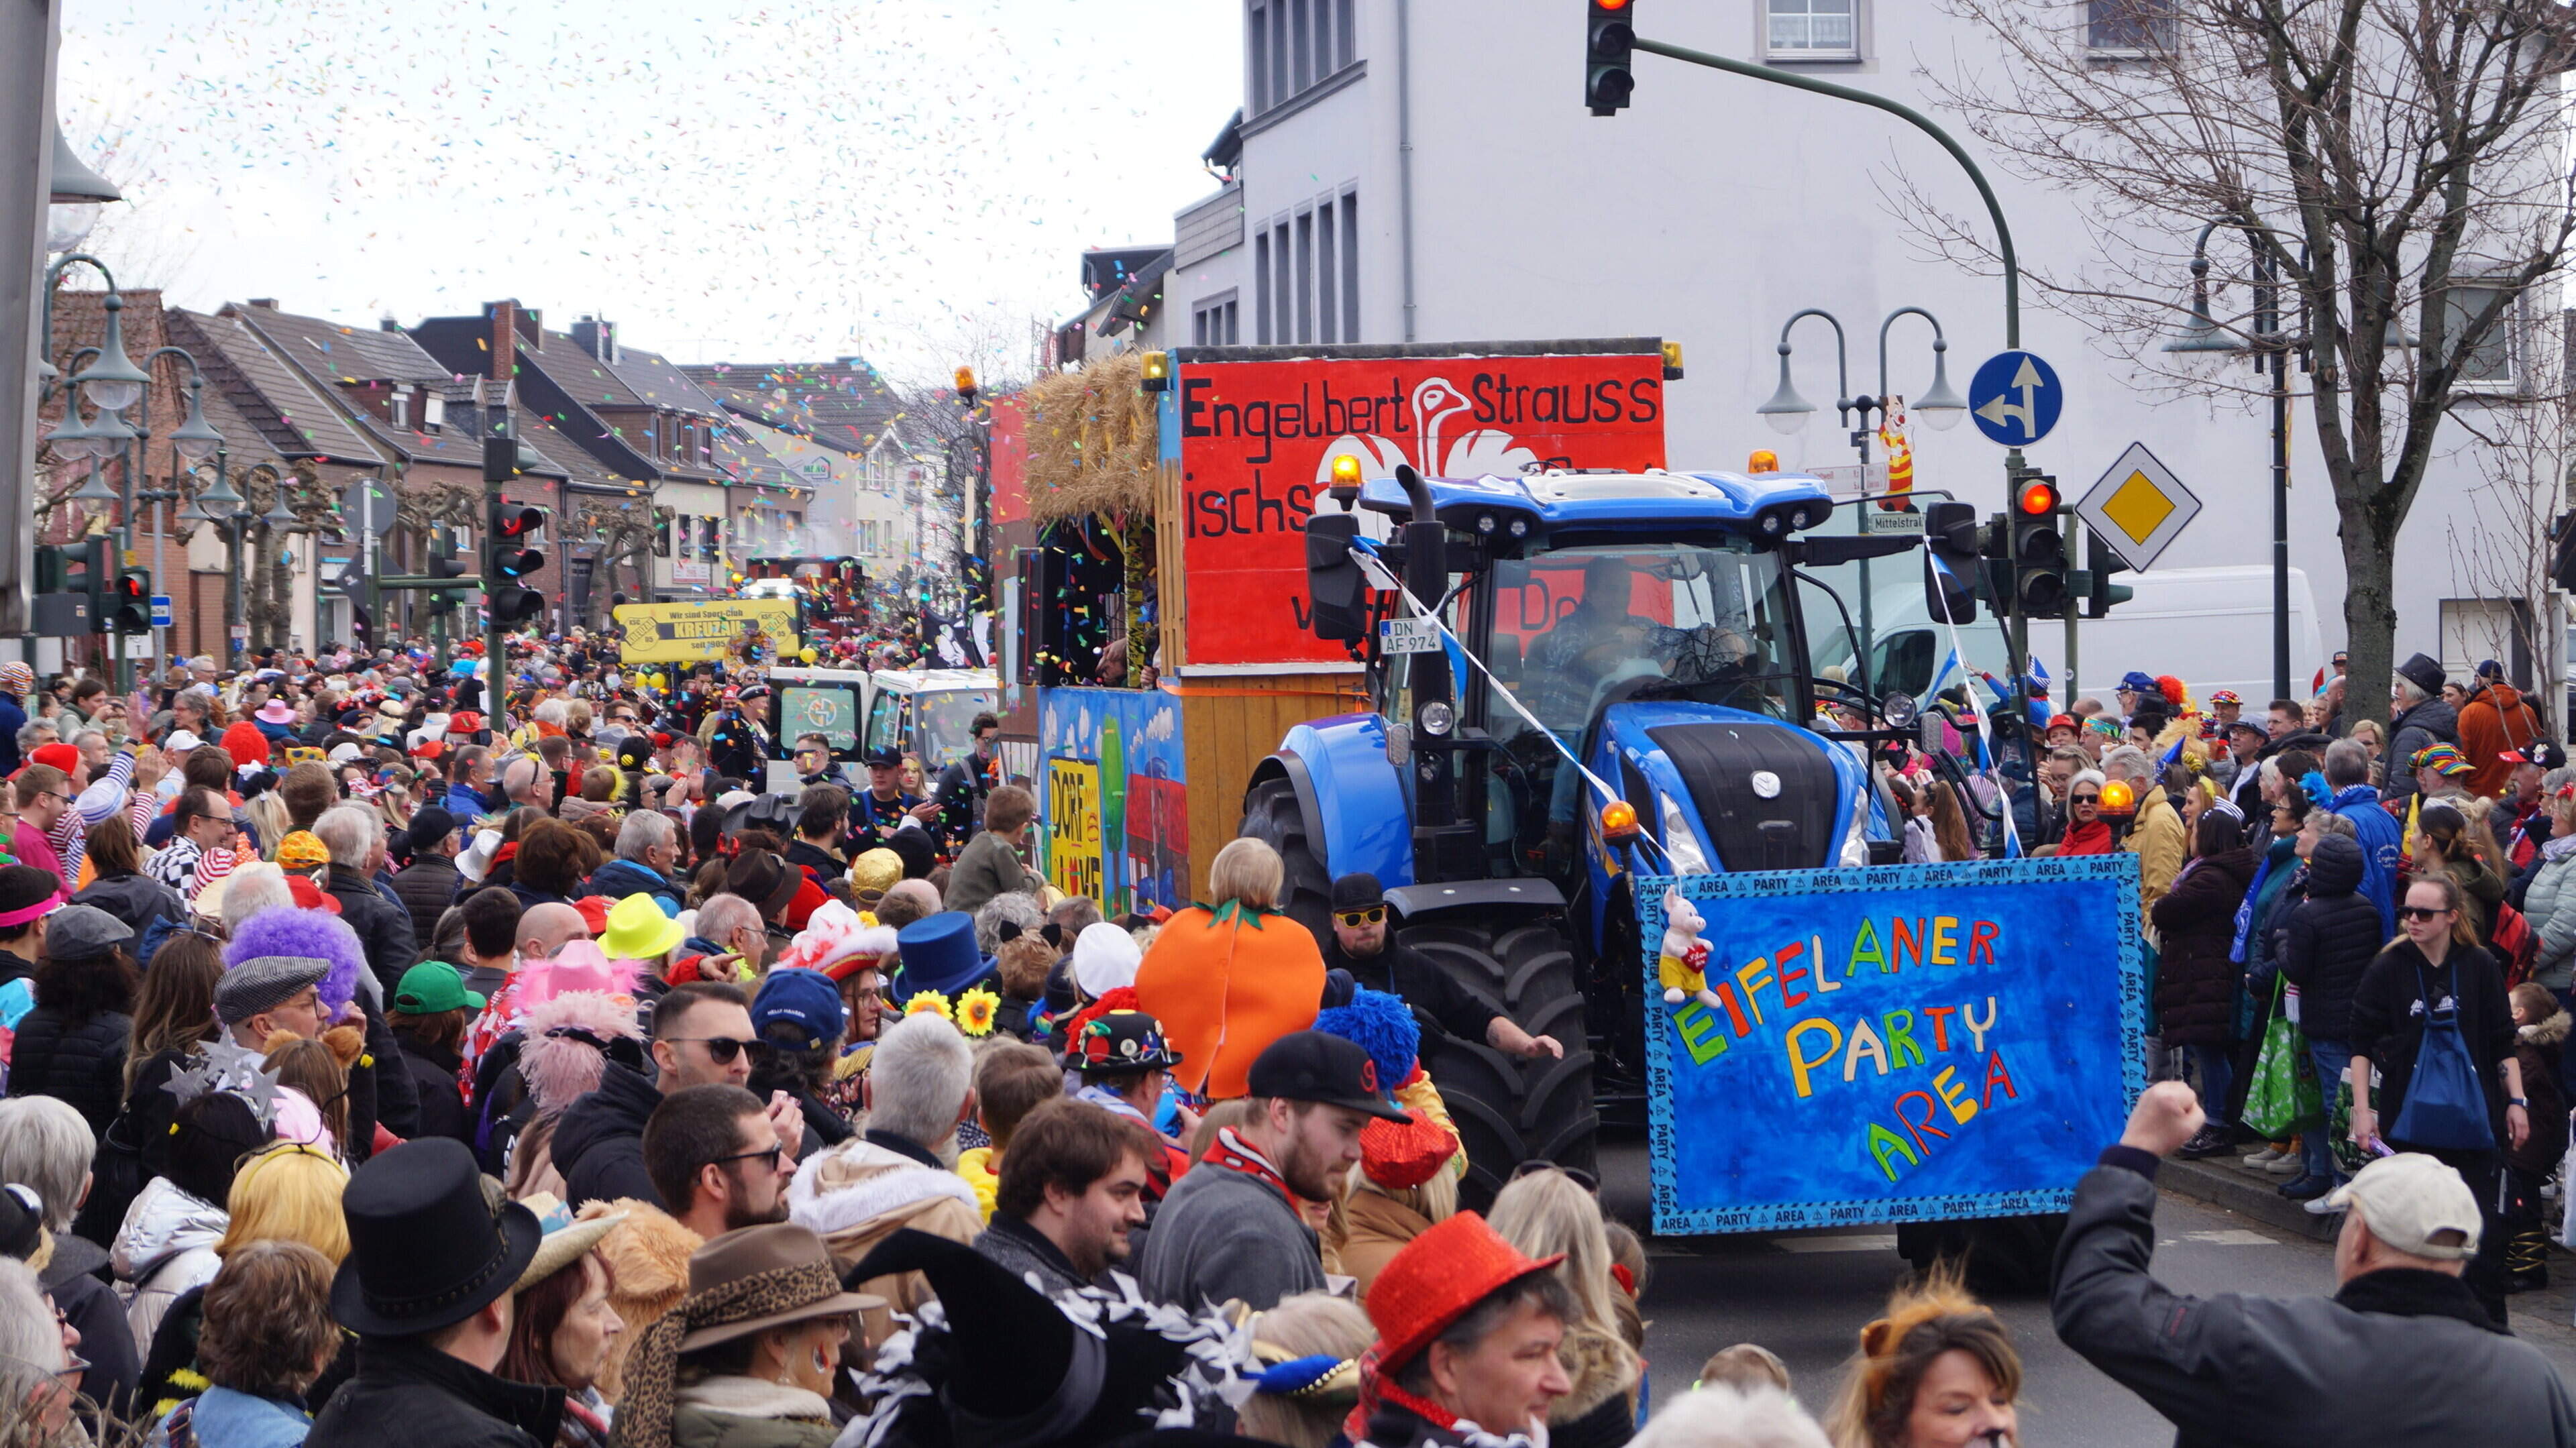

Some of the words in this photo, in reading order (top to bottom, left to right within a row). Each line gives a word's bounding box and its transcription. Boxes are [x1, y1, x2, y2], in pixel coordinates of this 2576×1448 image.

[1183, 378, 1409, 464] Engelbert
[1472, 373, 1659, 425] Strauss
[685, 610, 701, 618] sind
[1395, 622, 1413, 636] DN
[1386, 637, 1405, 652] AF
[1409, 634, 1436, 651] 974
[1052, 769, 1084, 843] DORF
[1699, 880, 1729, 893] AREA
[1754, 877, 1789, 891] PARTY
[1812, 875, 1841, 887] AREA
[1866, 871, 1901, 885] PARTY
[1924, 868, 1954, 882] AREA
[1979, 866, 2012, 879] PARTY
[2036, 863, 2065, 876] AREA
[2090, 860, 2124, 873] PARTY
[2124, 911, 2135, 948] PARTY
[1672, 916, 2000, 1066] EIFELANER
[2125, 971, 2137, 1001] AREA
[1652, 1007, 1664, 1043] PARTY
[1785, 996, 1996, 1099] PARTY
[2127, 1027, 2139, 1063] PARTY
[1654, 1066, 1666, 1098] AREA
[1867, 1049, 2018, 1183] AREA
[1656, 1123, 1669, 1160] PARTY
[1658, 1184, 1670, 1217] AREA
[1661, 1217, 1691, 1230] AREA
[1716, 1213, 1751, 1226] PARTY
[1775, 1210, 1805, 1223] AREA
[1830, 1207, 1865, 1220] PARTY
[1888, 1203, 1919, 1217] AREA
[1943, 1201, 1977, 1214] PARTY
[2000, 1196, 2029, 1210] AREA
